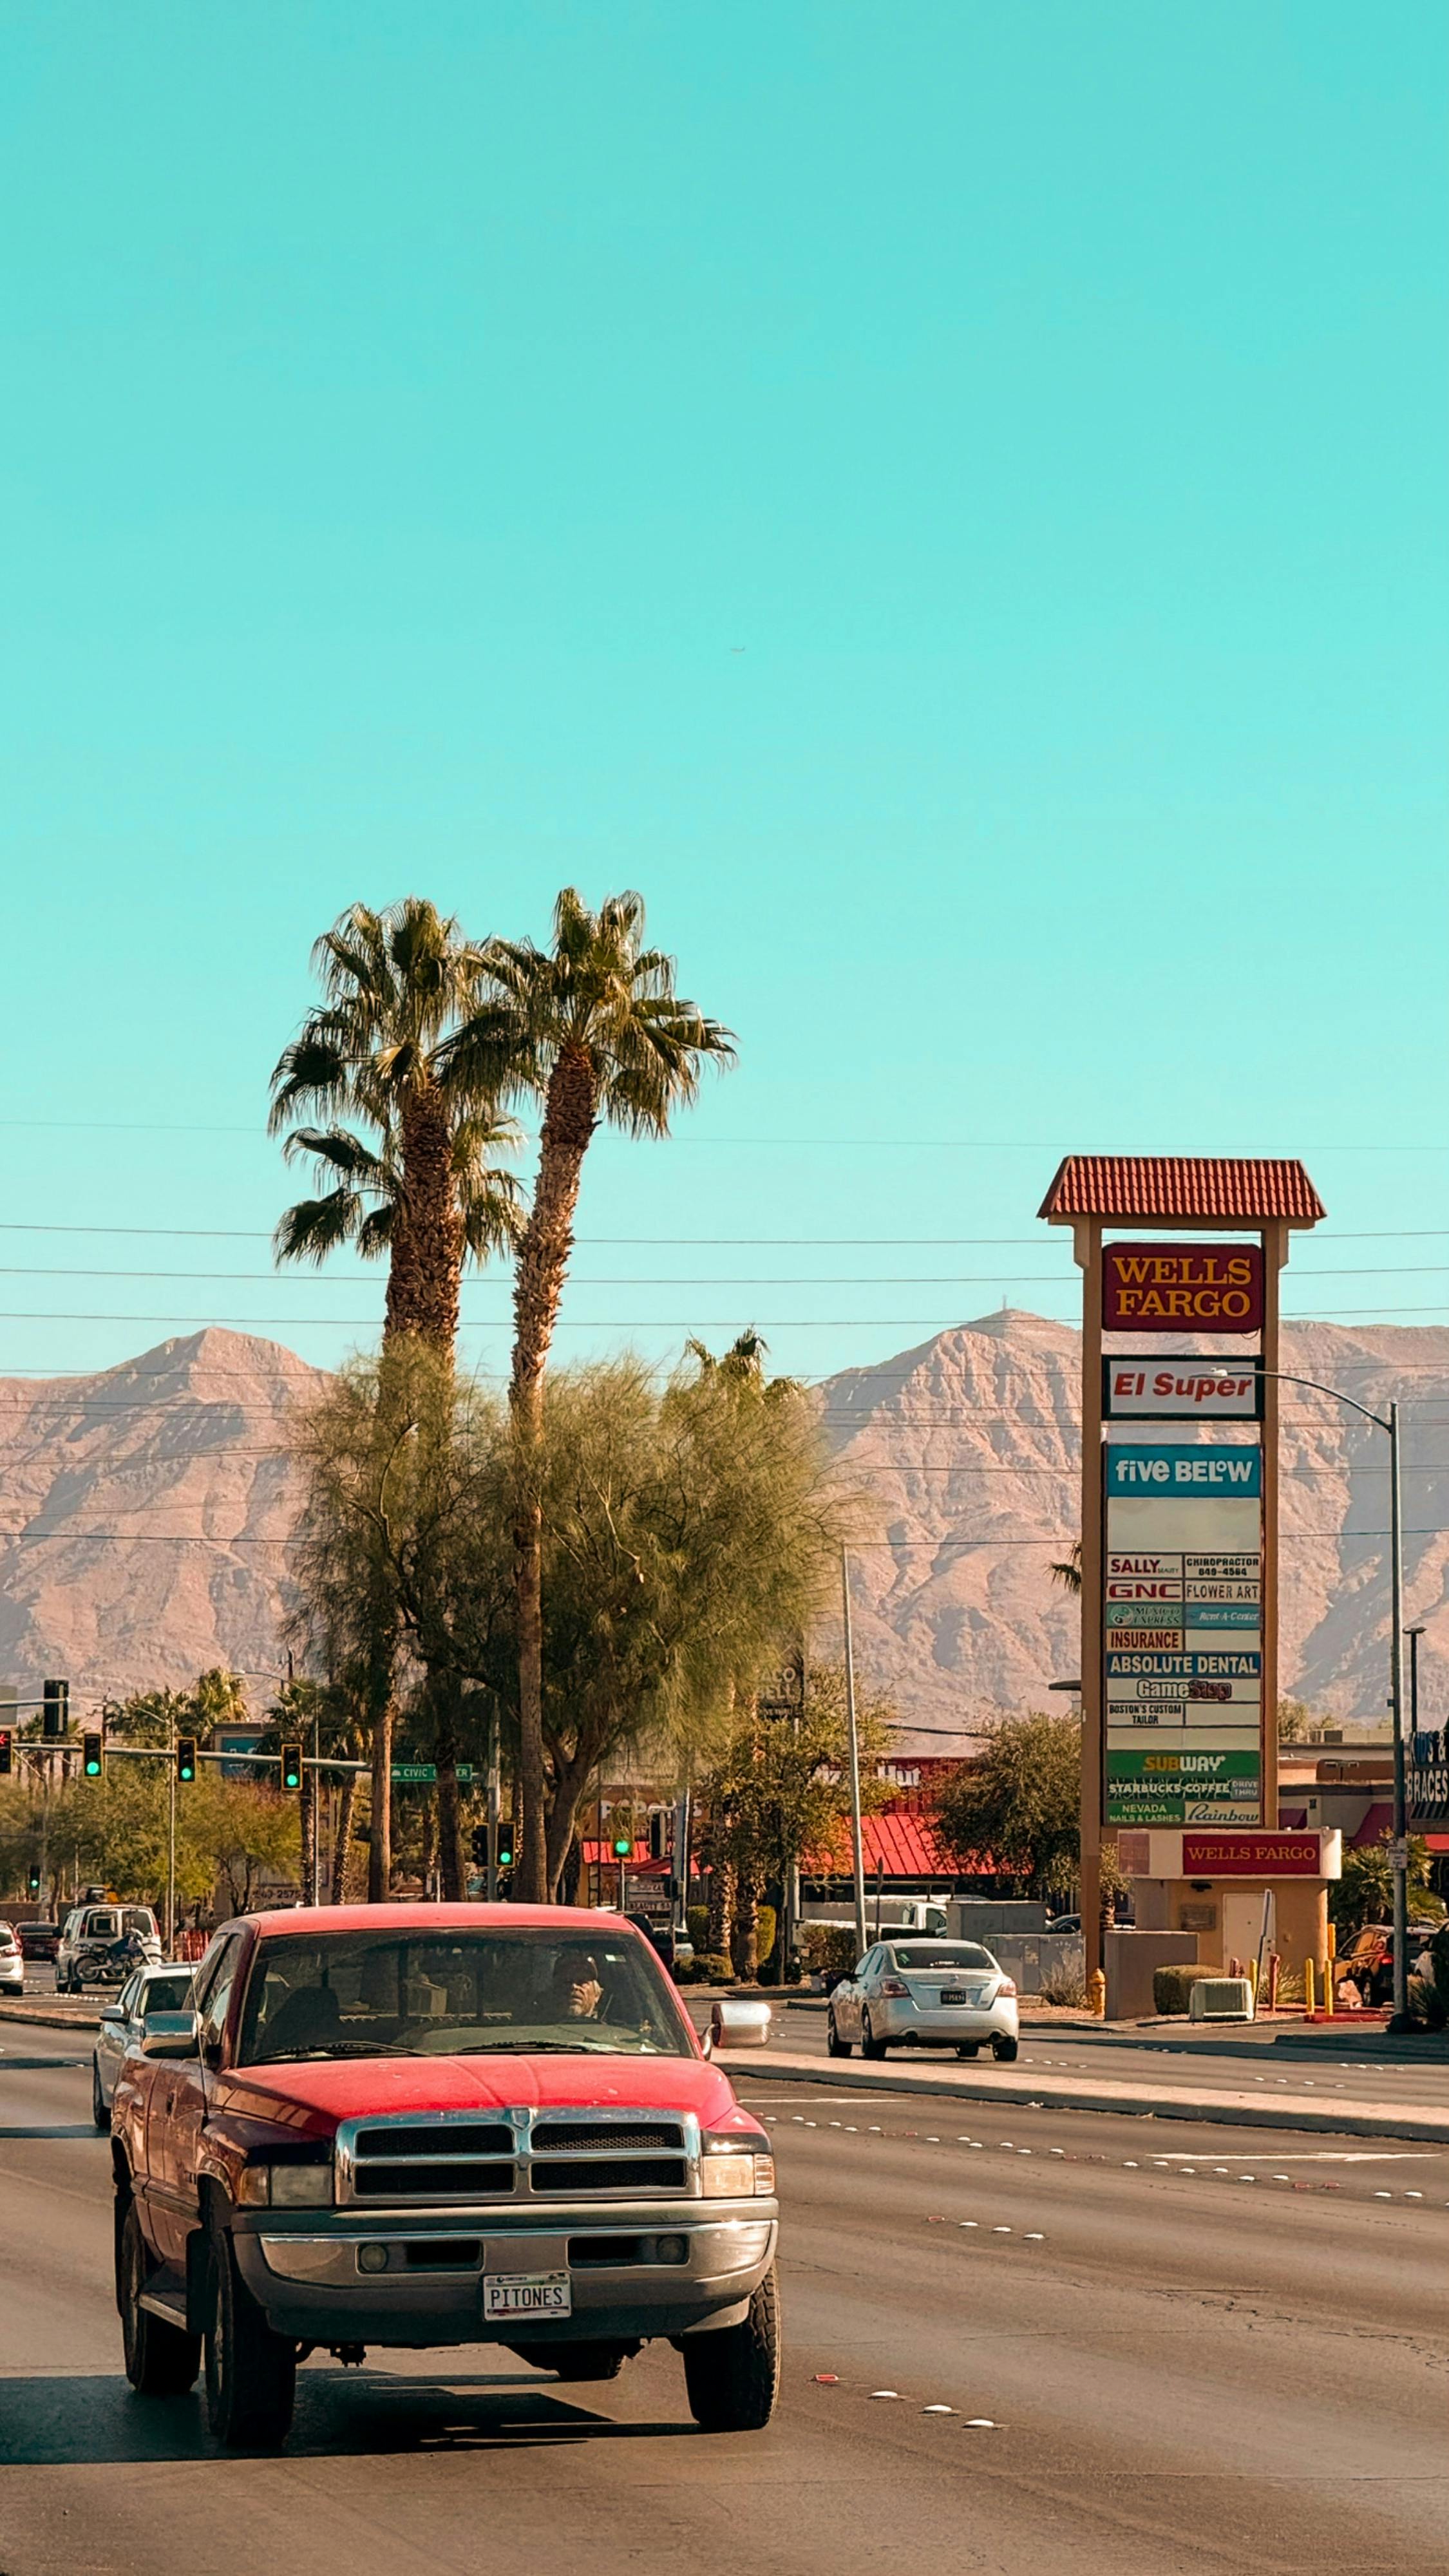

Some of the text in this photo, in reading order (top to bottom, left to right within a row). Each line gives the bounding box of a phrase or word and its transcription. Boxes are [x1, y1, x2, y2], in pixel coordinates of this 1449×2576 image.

[1112, 1257, 1251, 1285] WELLS
[1116, 1289, 1251, 1318] FARGO
[1114, 1372, 1252, 1402] El Super
[1111, 1558, 1160, 1573] SALLY
[1186, 1557, 1259, 1567] CHIROPRACTOR
[1109, 1583, 1181, 1598] GNC
[1186, 1584, 1258, 1599] FLOWER ART
[1110, 1631, 1179, 1649] INSURANCE
[1110, 1655, 1258, 1674] ABSOLUTE DENTAL
[1137, 1679, 1233, 1700] GameStop
[1109, 1704, 1182, 1714] BOSTON'S CUSTOM
[1132, 1714, 1159, 1724] TAILOR
[1142, 1756, 1220, 1772] SUBWAY
[403, 1768, 428, 1777] CIVIC
[1109, 1783, 1230, 1794] STARBUCKS COFFEE
[1232, 1780, 1258, 1788] DRIVE
[1407, 1768, 1448, 1803] BRACES
[1234, 1788, 1258, 1797] THRU
[1122, 1804, 1168, 1814] NEVADA
[1187, 1803, 1259, 1823] Rainbow
[1145, 1814, 1181, 1823] LASHES
[1187, 1846, 1316, 1861] WELLS FARGO
[491, 2287, 562, 2307] PITONES
